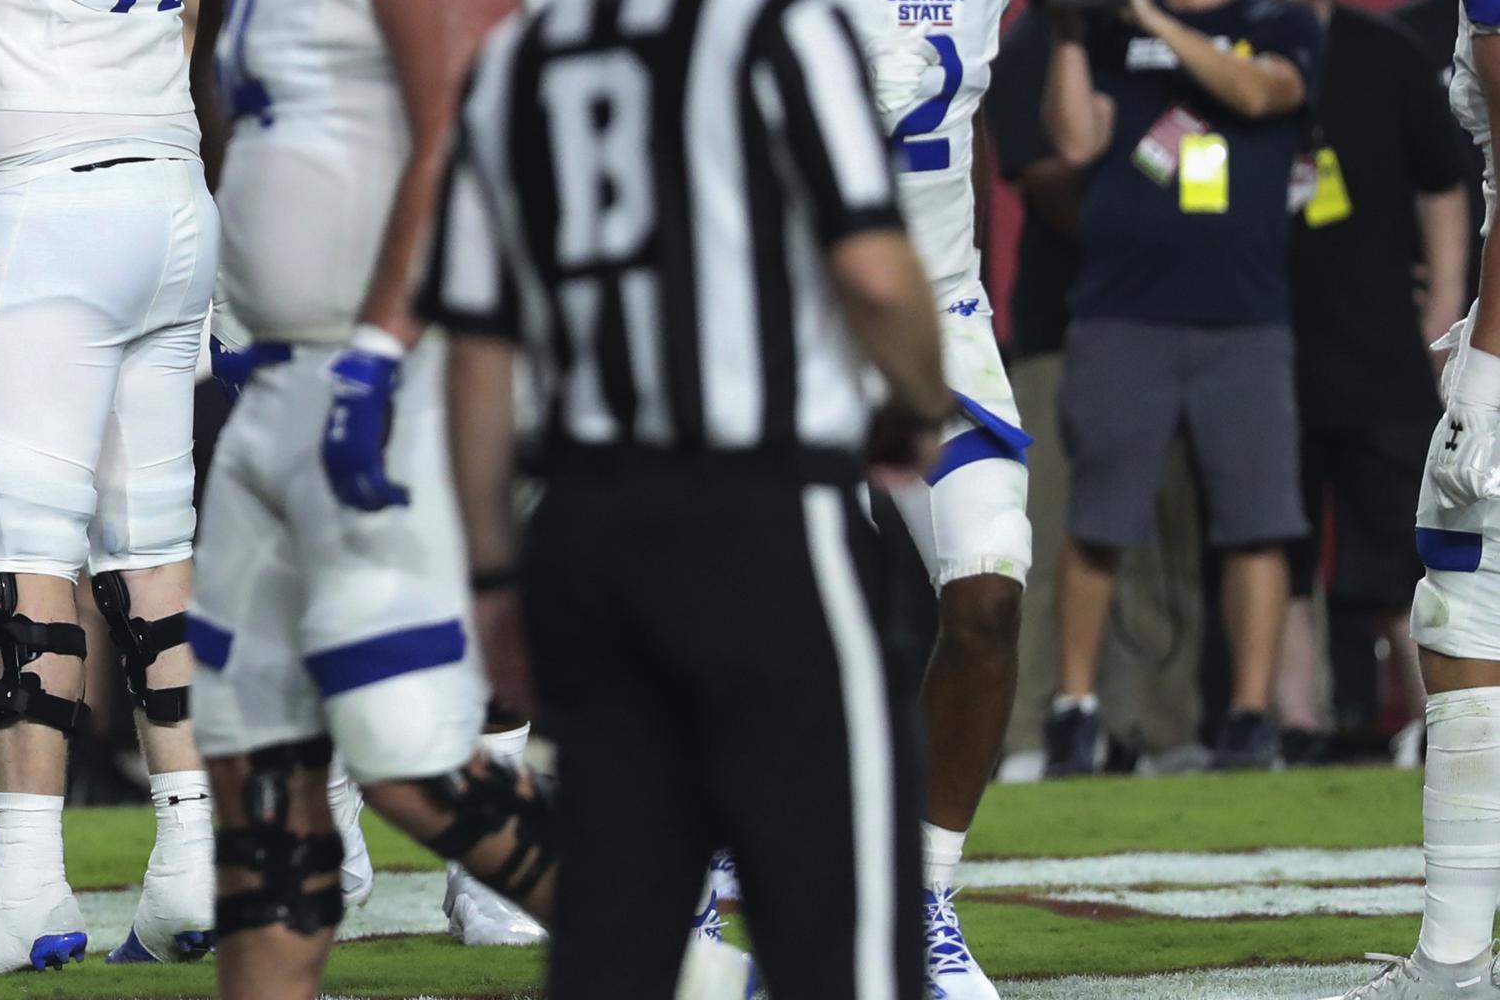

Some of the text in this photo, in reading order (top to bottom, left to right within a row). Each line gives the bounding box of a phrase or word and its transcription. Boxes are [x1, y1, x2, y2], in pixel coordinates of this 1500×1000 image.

[898, 3, 953, 21] STATE
[537, 50, 656, 266] B
[890, 34, 964, 172] 2
